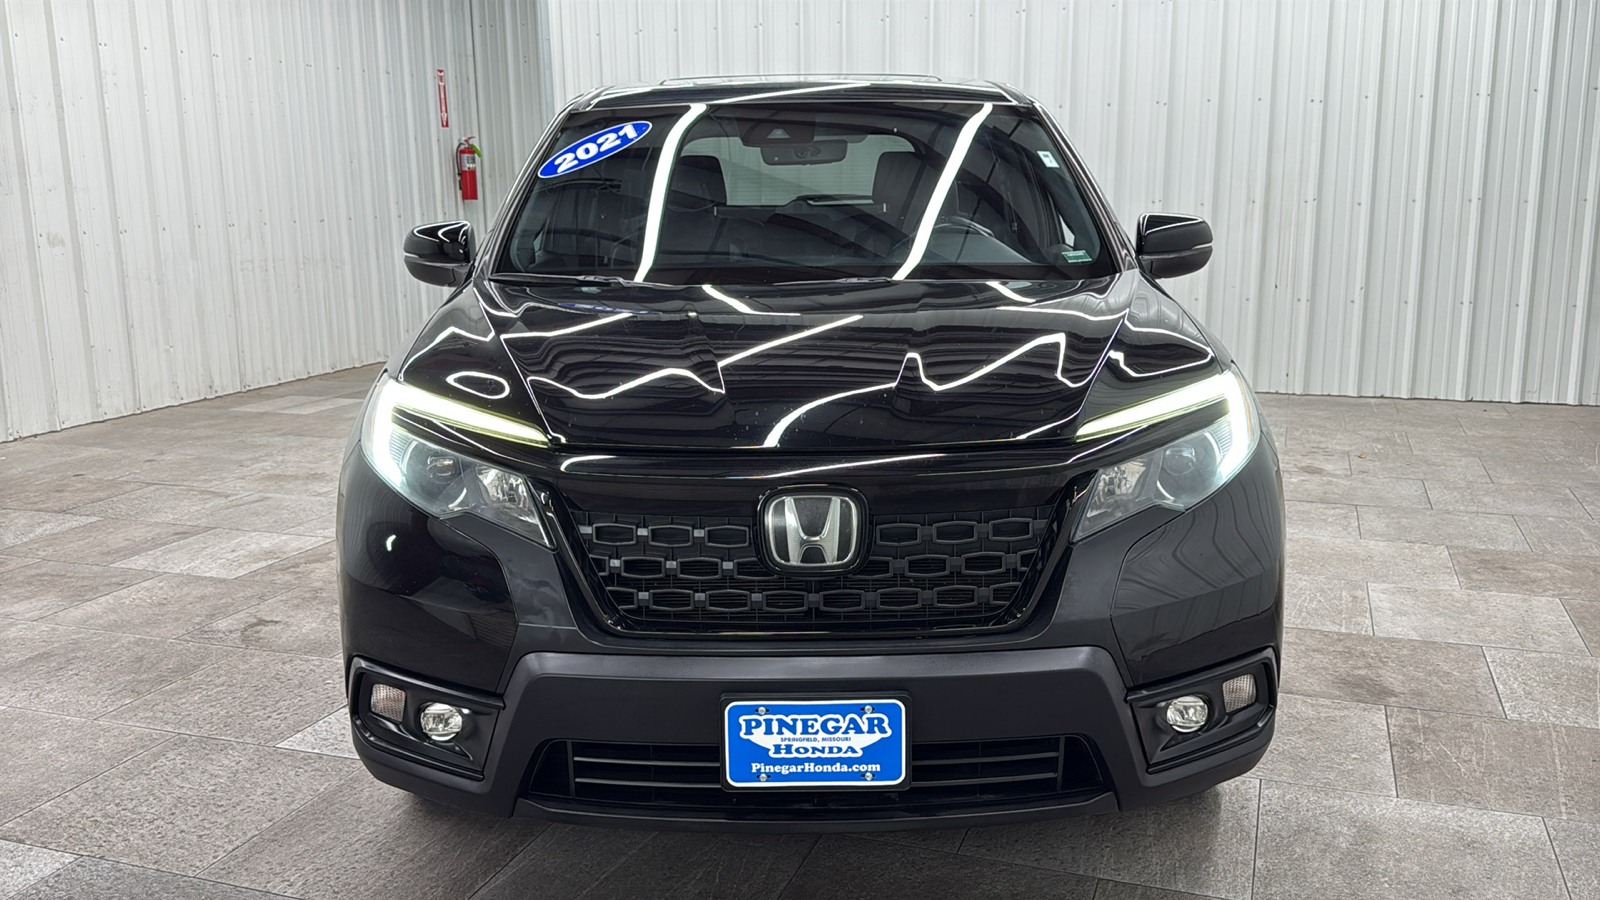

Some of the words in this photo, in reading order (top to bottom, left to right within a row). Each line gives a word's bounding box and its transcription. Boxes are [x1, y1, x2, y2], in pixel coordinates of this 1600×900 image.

[554, 124, 638, 174] 2021
[742, 716, 889, 736] PINEGAR
[772, 744, 859, 755] HONDA
[751, 762, 881, 775] PinegarHonda.com
